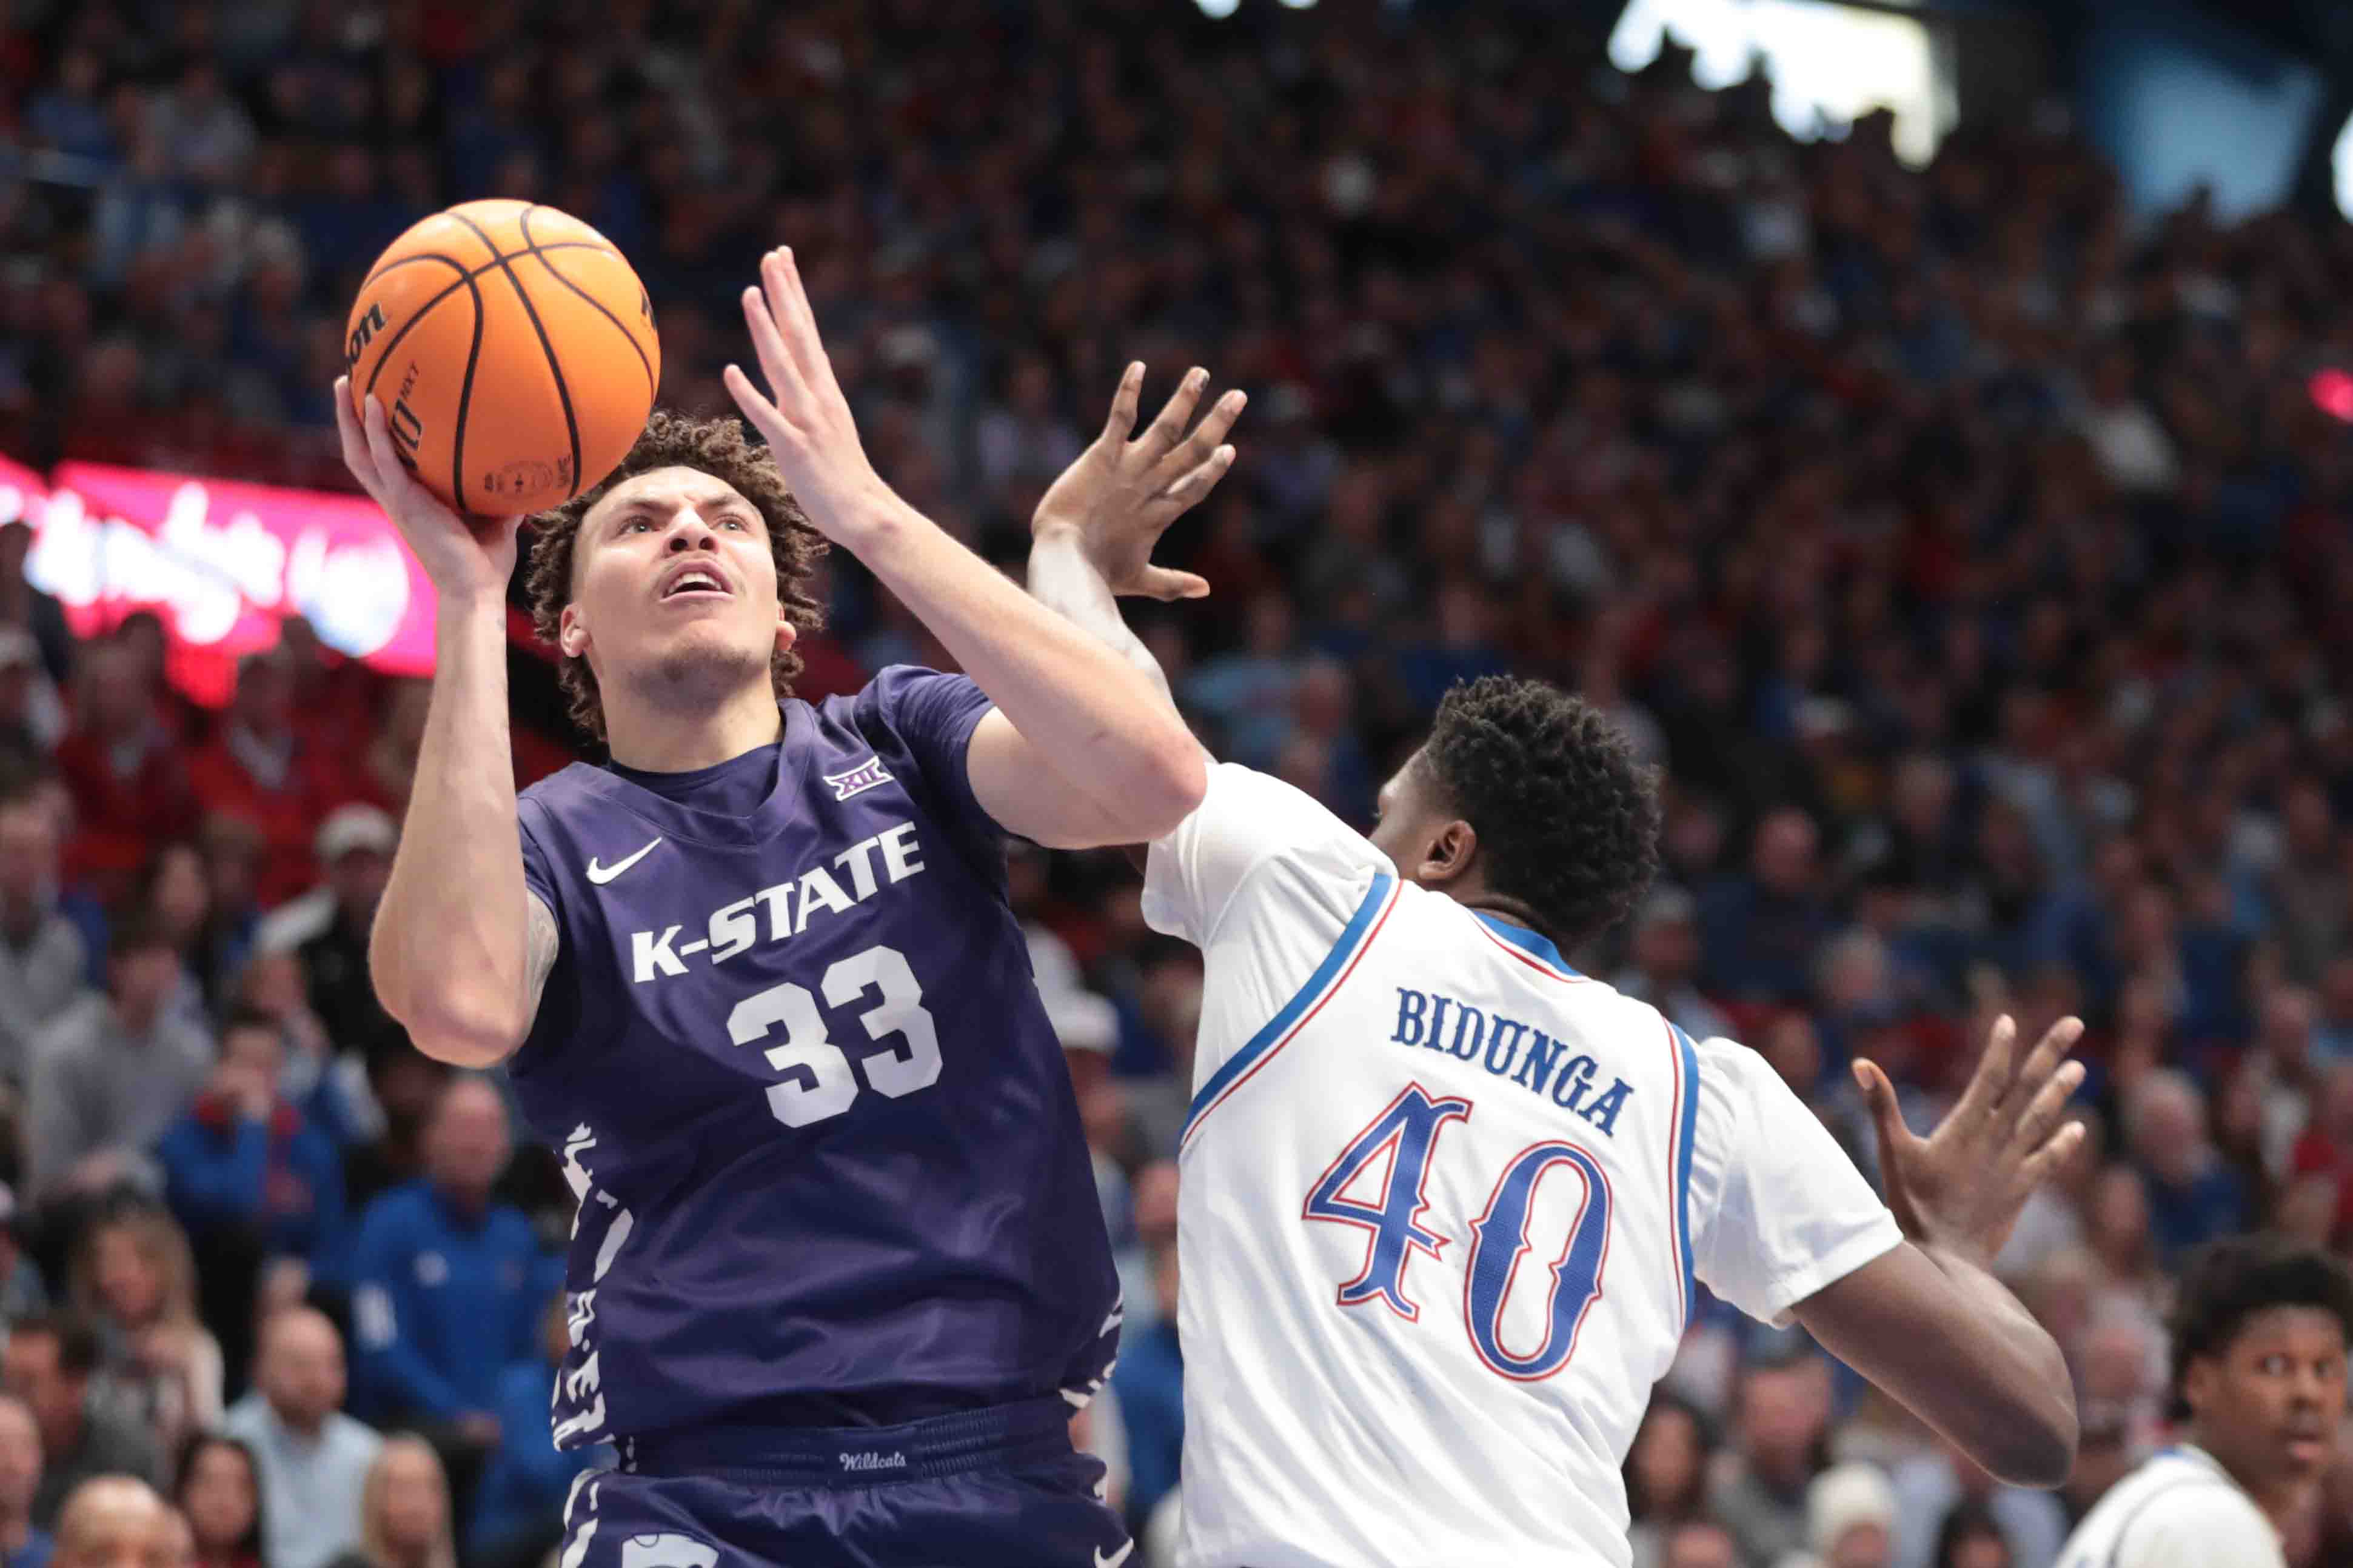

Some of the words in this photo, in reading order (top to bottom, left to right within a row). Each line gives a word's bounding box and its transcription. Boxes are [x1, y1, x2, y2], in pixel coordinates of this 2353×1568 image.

[348, 302, 388, 369] on
[632, 821, 925, 983] K-STATE
[727, 945, 943, 1128] 33
[1390, 987, 1635, 1138] BIDUNGA
[1302, 1081, 1613, 1382] 40
[839, 1451, 907, 1472] Wildcats
